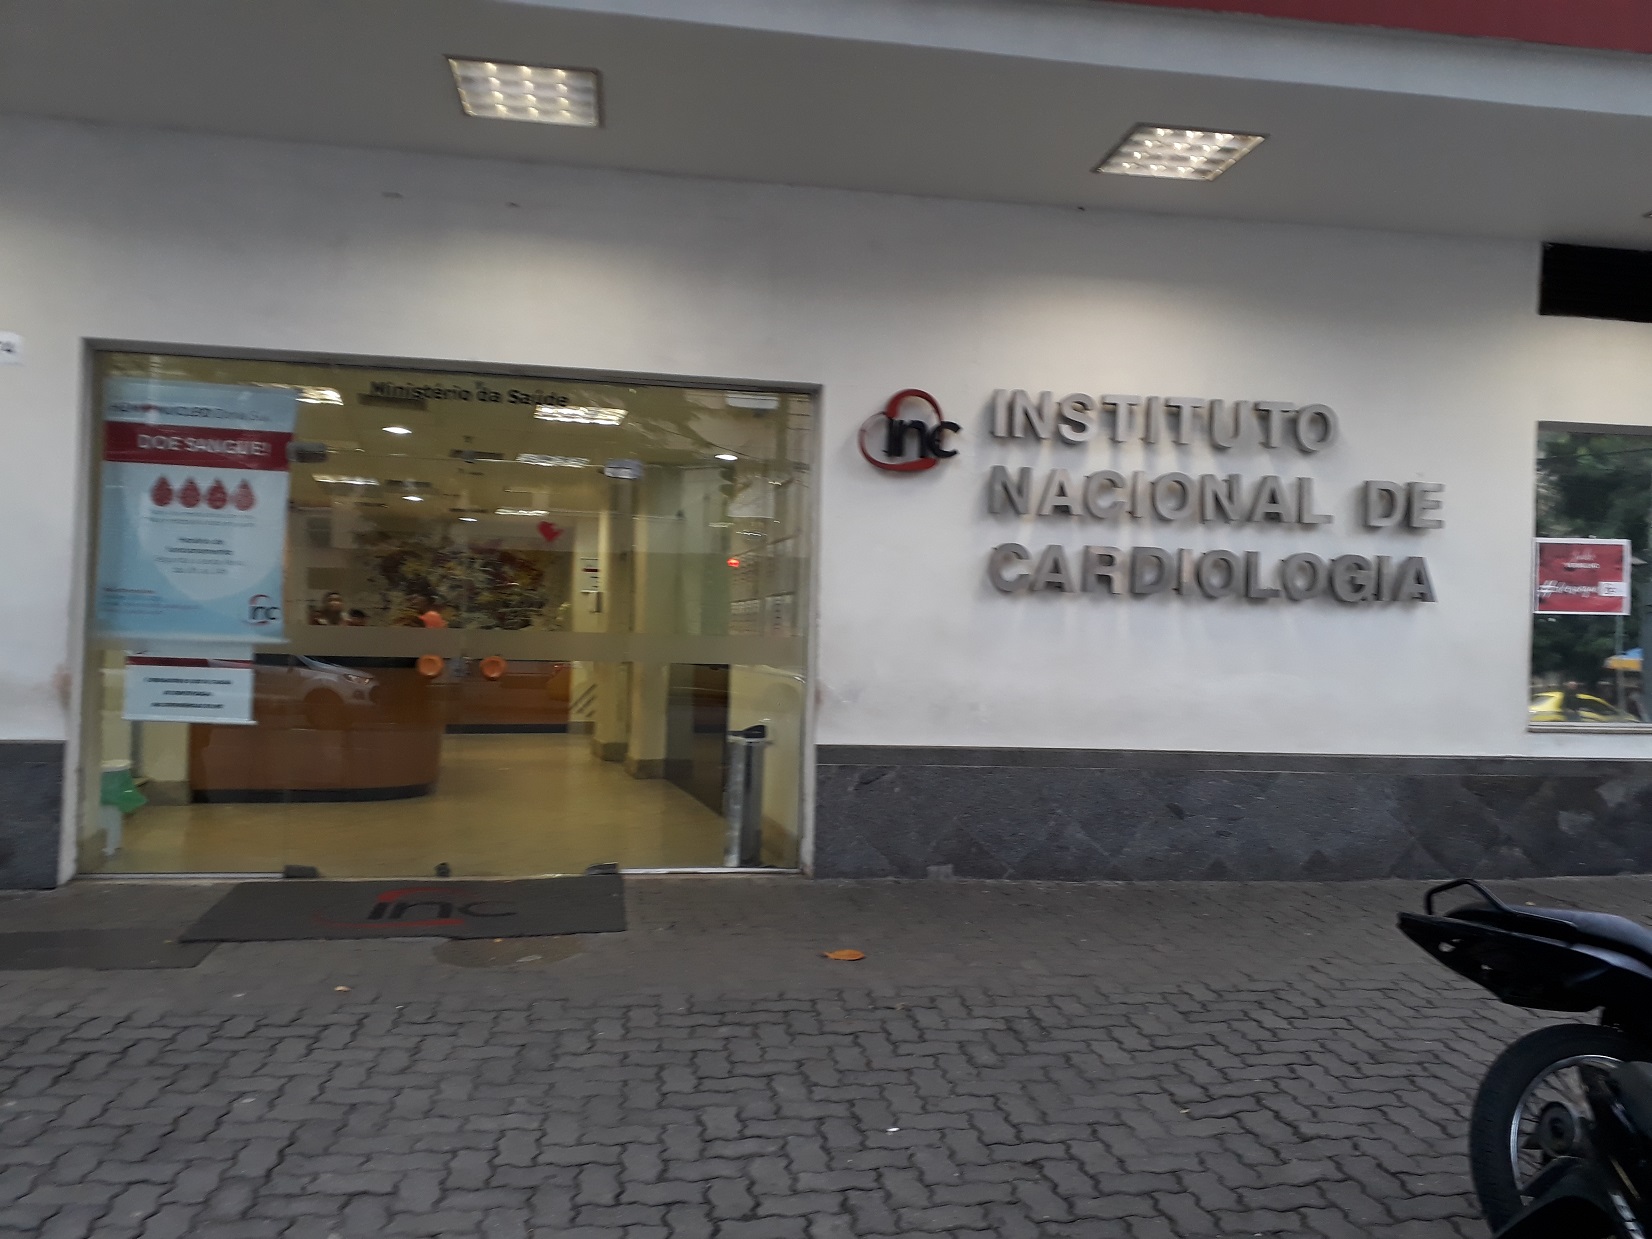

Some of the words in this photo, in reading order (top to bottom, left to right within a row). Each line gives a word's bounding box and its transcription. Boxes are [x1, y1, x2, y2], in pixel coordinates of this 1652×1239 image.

[370, 380, 470, 401] Ministério
[474, 381, 501, 403] da
[507, 388, 570, 407] Saúde
[989, 388, 1338, 452] INSTITUTO
[136, 434, 182, 451] DOE
[883, 414, 960, 461] inc
[989, 464, 1334, 526] NACIONAL
[1363, 479, 1446, 530] DE
[987, 541, 1438, 604] CARDIOLOGIA
